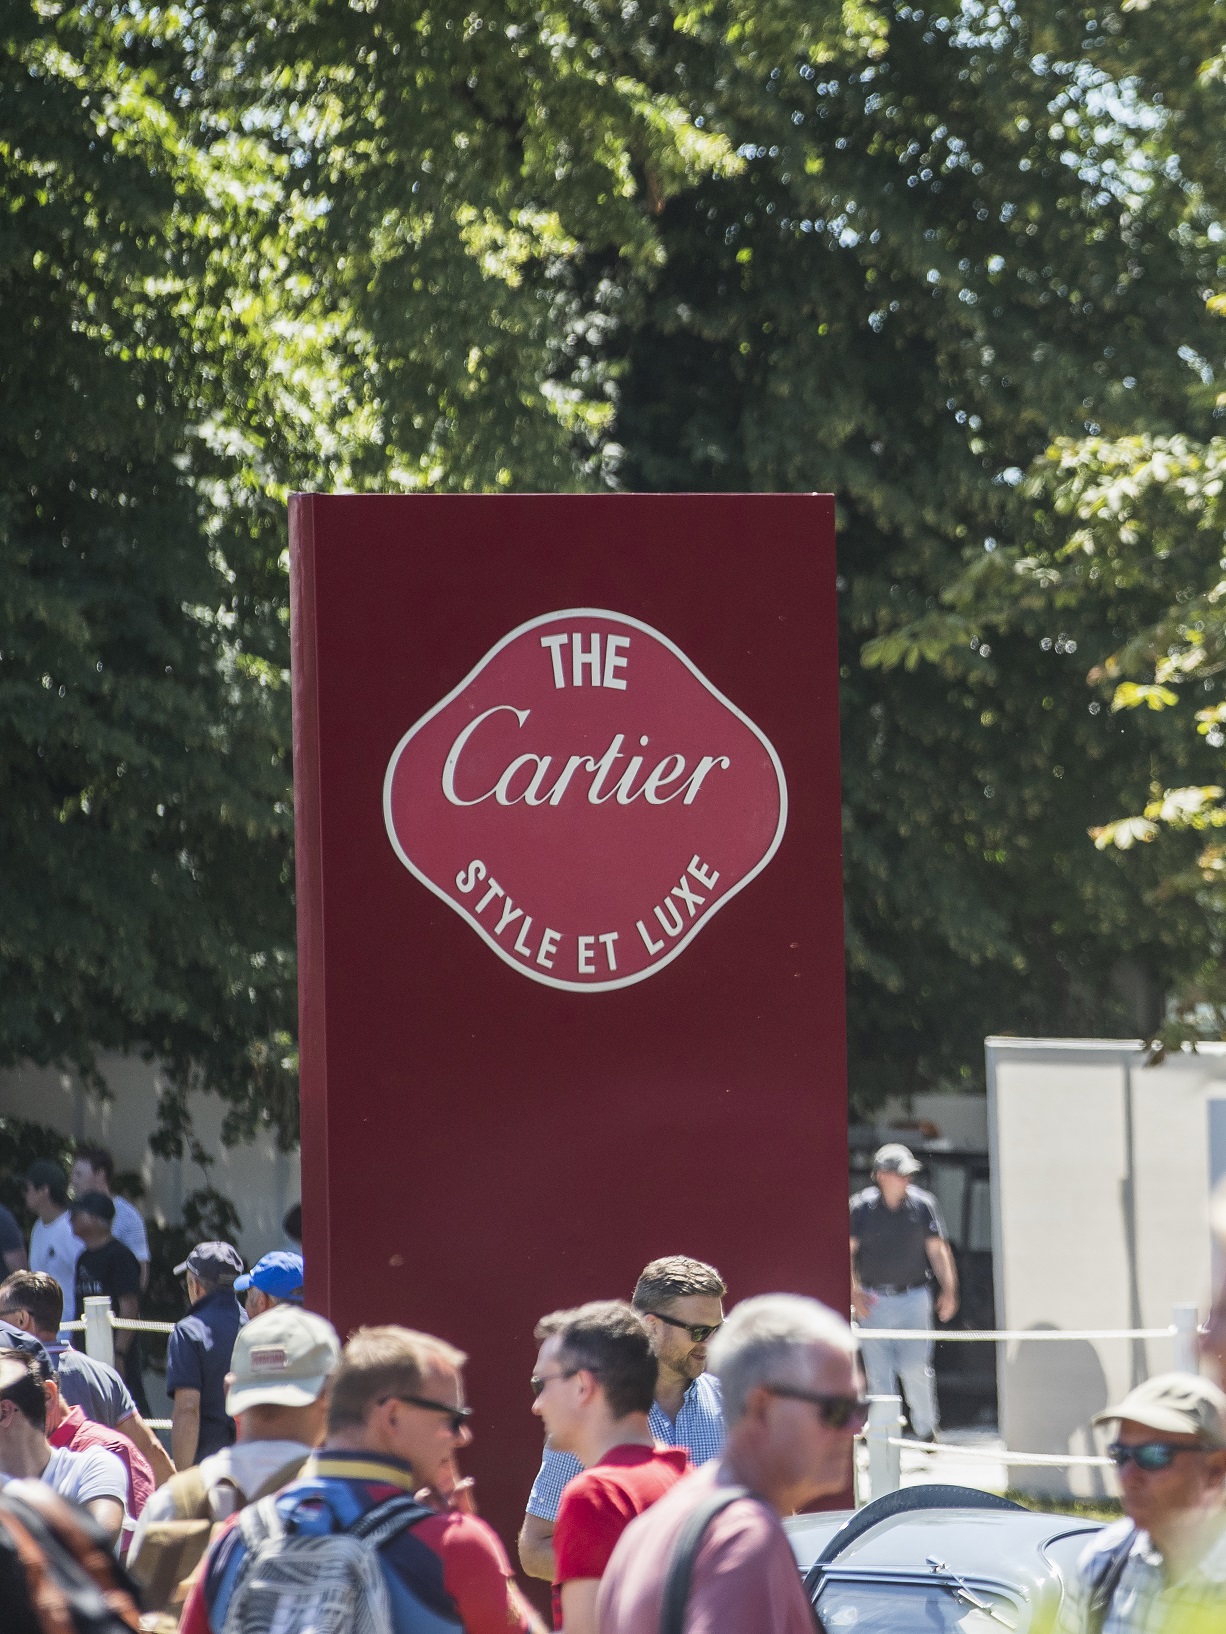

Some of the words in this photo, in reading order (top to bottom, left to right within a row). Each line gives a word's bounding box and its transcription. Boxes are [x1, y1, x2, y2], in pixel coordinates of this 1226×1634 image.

[540, 632, 631, 691] THE
[441, 704, 731, 807] Cartier
[455, 859, 565, 970] STYLE
[577, 931, 620, 975] ET
[635, 854, 721, 957] LUXE
